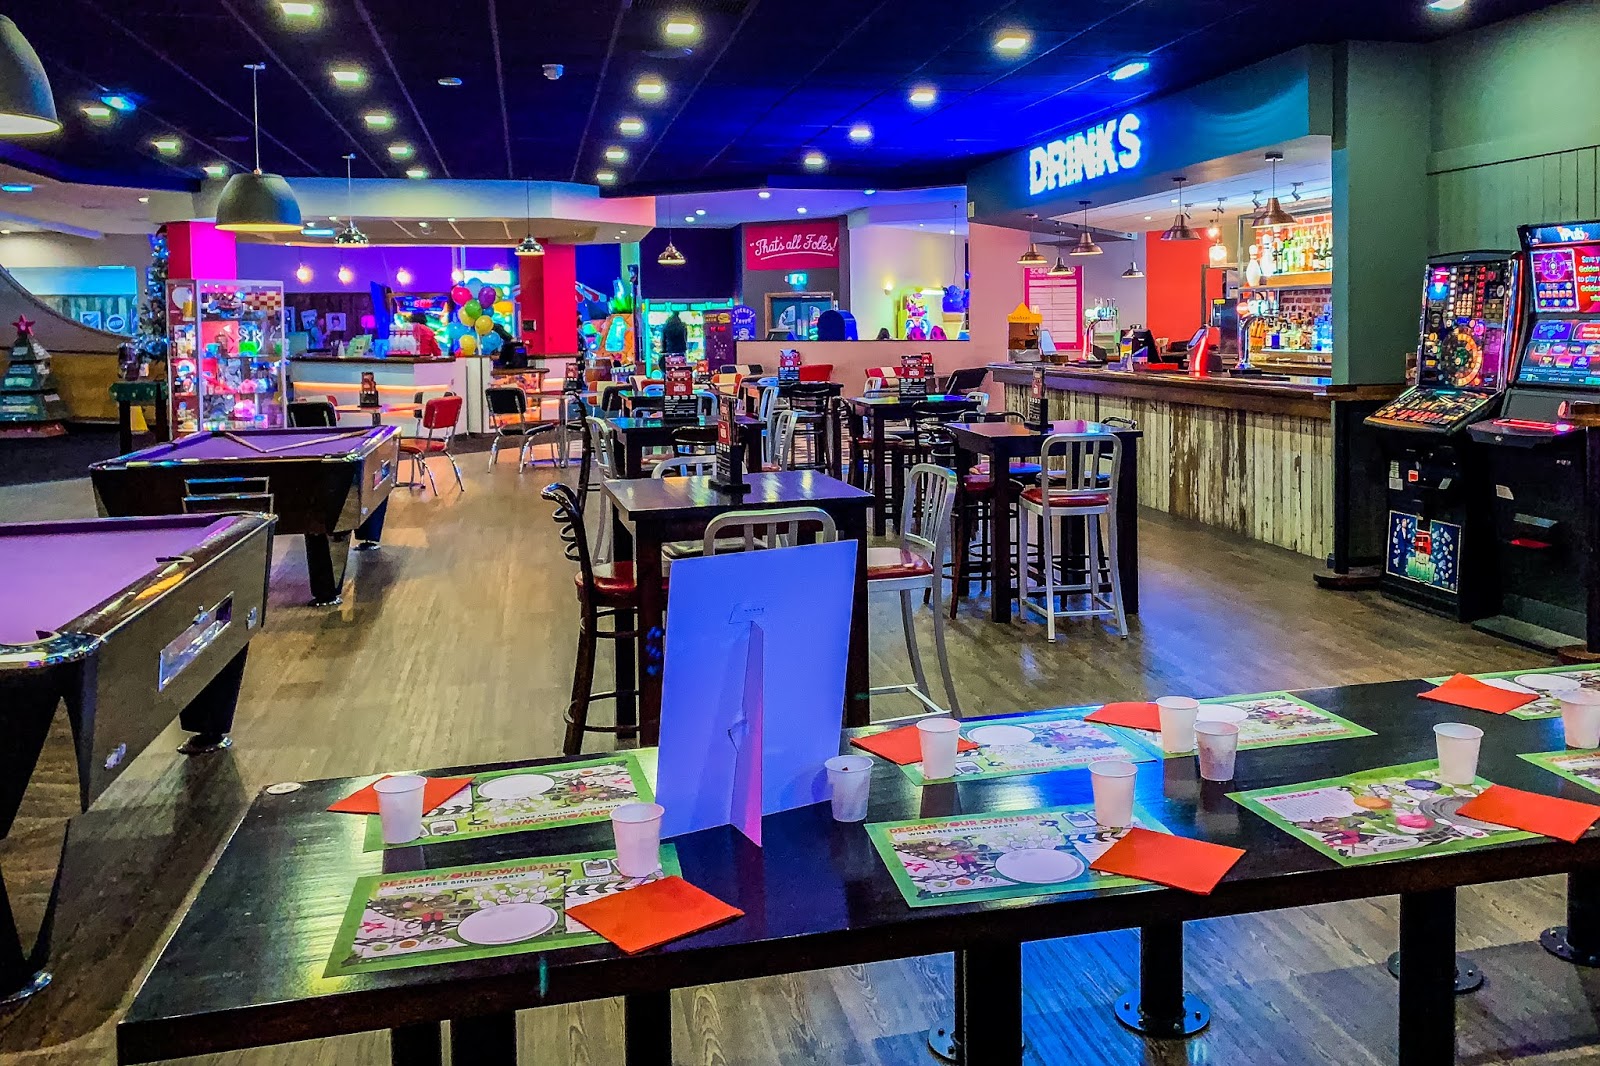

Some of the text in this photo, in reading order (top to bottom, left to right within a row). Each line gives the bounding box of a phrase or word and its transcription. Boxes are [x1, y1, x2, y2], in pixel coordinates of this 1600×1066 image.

[1029, 113, 1141, 195] DRINKS
[786, 234, 802, 249] all
[803, 234, 839, 252] Folks!
[889, 823, 938, 834] DESIGN
[938, 820, 977, 829] YOUR
[980, 816, 1014, 825] OWN
[380, 876, 436, 887] DESIGN
[440, 870, 483, 880] YOUR
[486, 866, 526, 876] OWN
